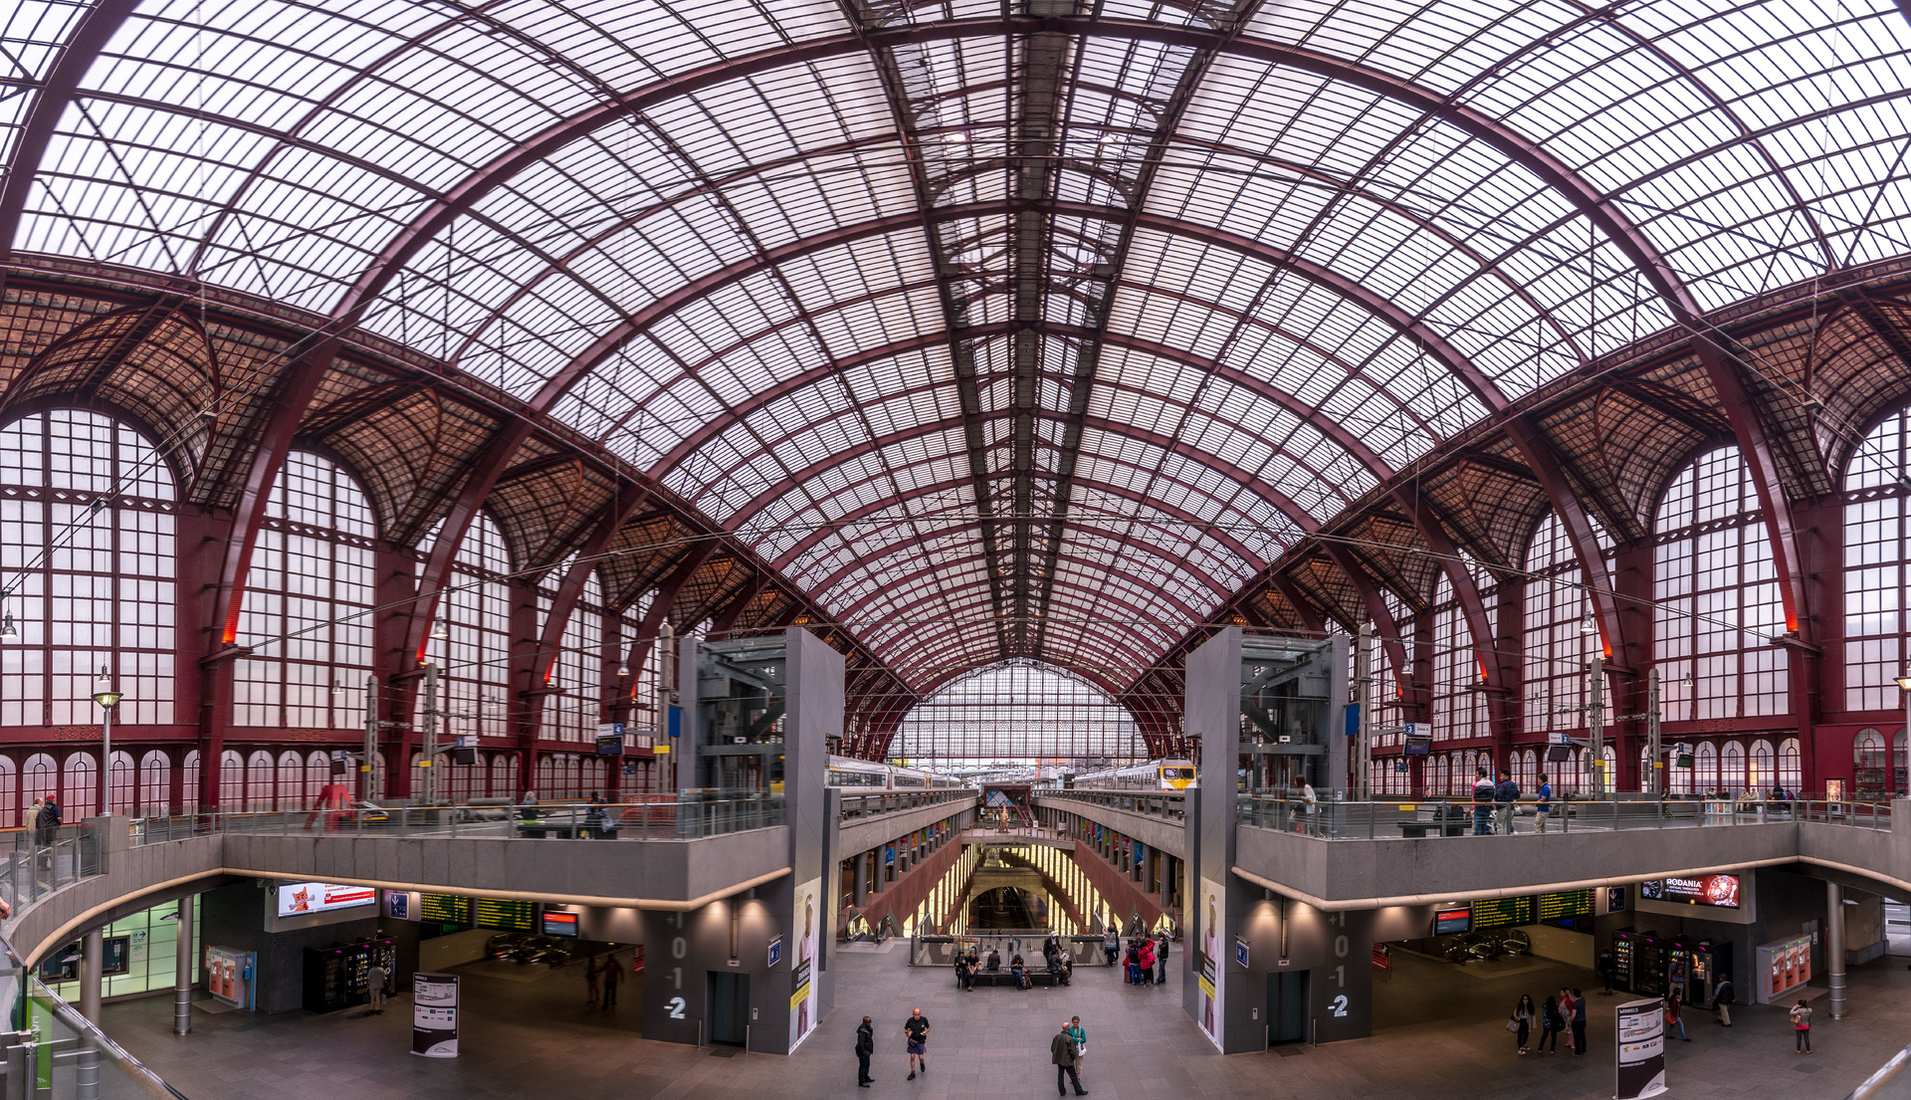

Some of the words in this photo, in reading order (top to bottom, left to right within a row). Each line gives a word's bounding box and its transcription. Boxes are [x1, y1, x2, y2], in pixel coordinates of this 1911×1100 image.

[1666, 878, 1702, 888] RODANIA
[672, 936, 687, 959] 0
[1335, 935, 1349, 958] 0
[665, 967, 682, 990] -1
[1328, 965, 1345, 988] -1
[664, 996, 686, 1019] -2
[1328, 994, 1348, 1017] -2
